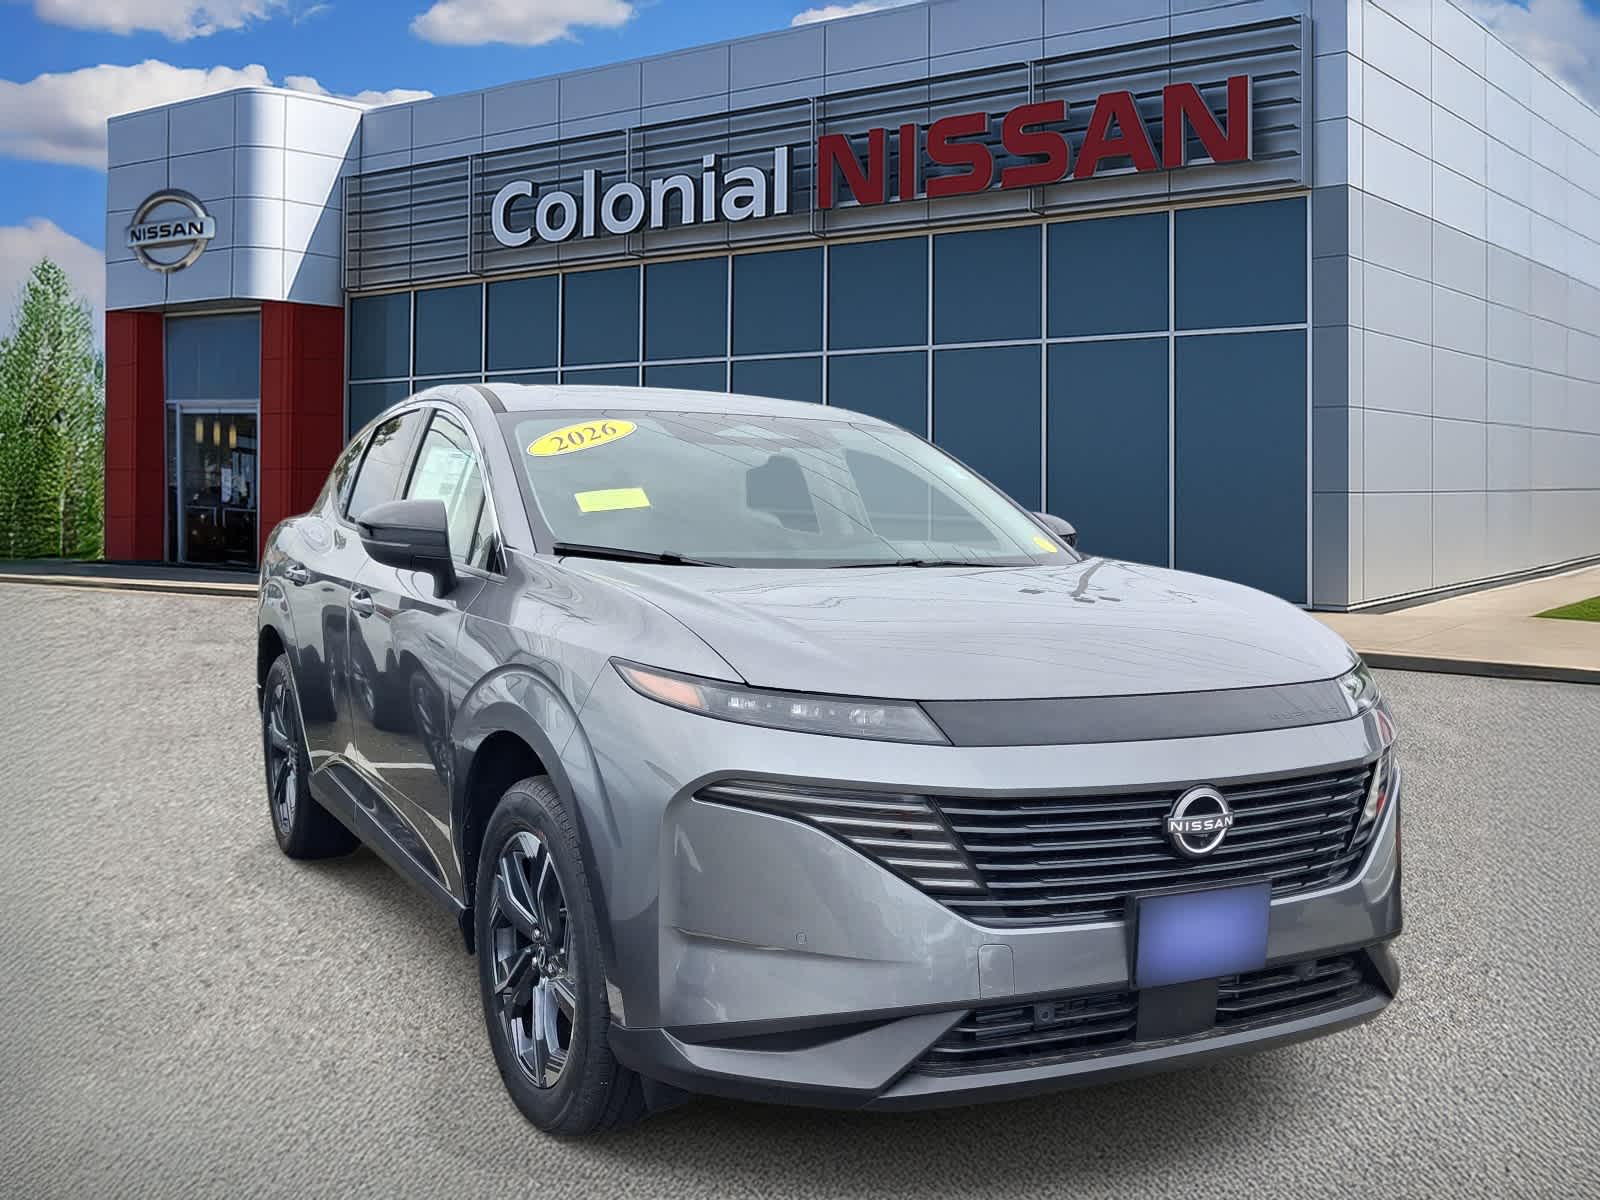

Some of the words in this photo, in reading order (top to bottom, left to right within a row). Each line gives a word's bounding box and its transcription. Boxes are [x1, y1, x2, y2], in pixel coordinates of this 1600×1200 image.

[491, 145, 790, 248] Colonial
[817, 74, 1251, 209] NISSAN
[130, 221, 204, 242] NISSAN
[550, 422, 617, 451] 2026
[1170, 815, 1233, 832] NISSAN
